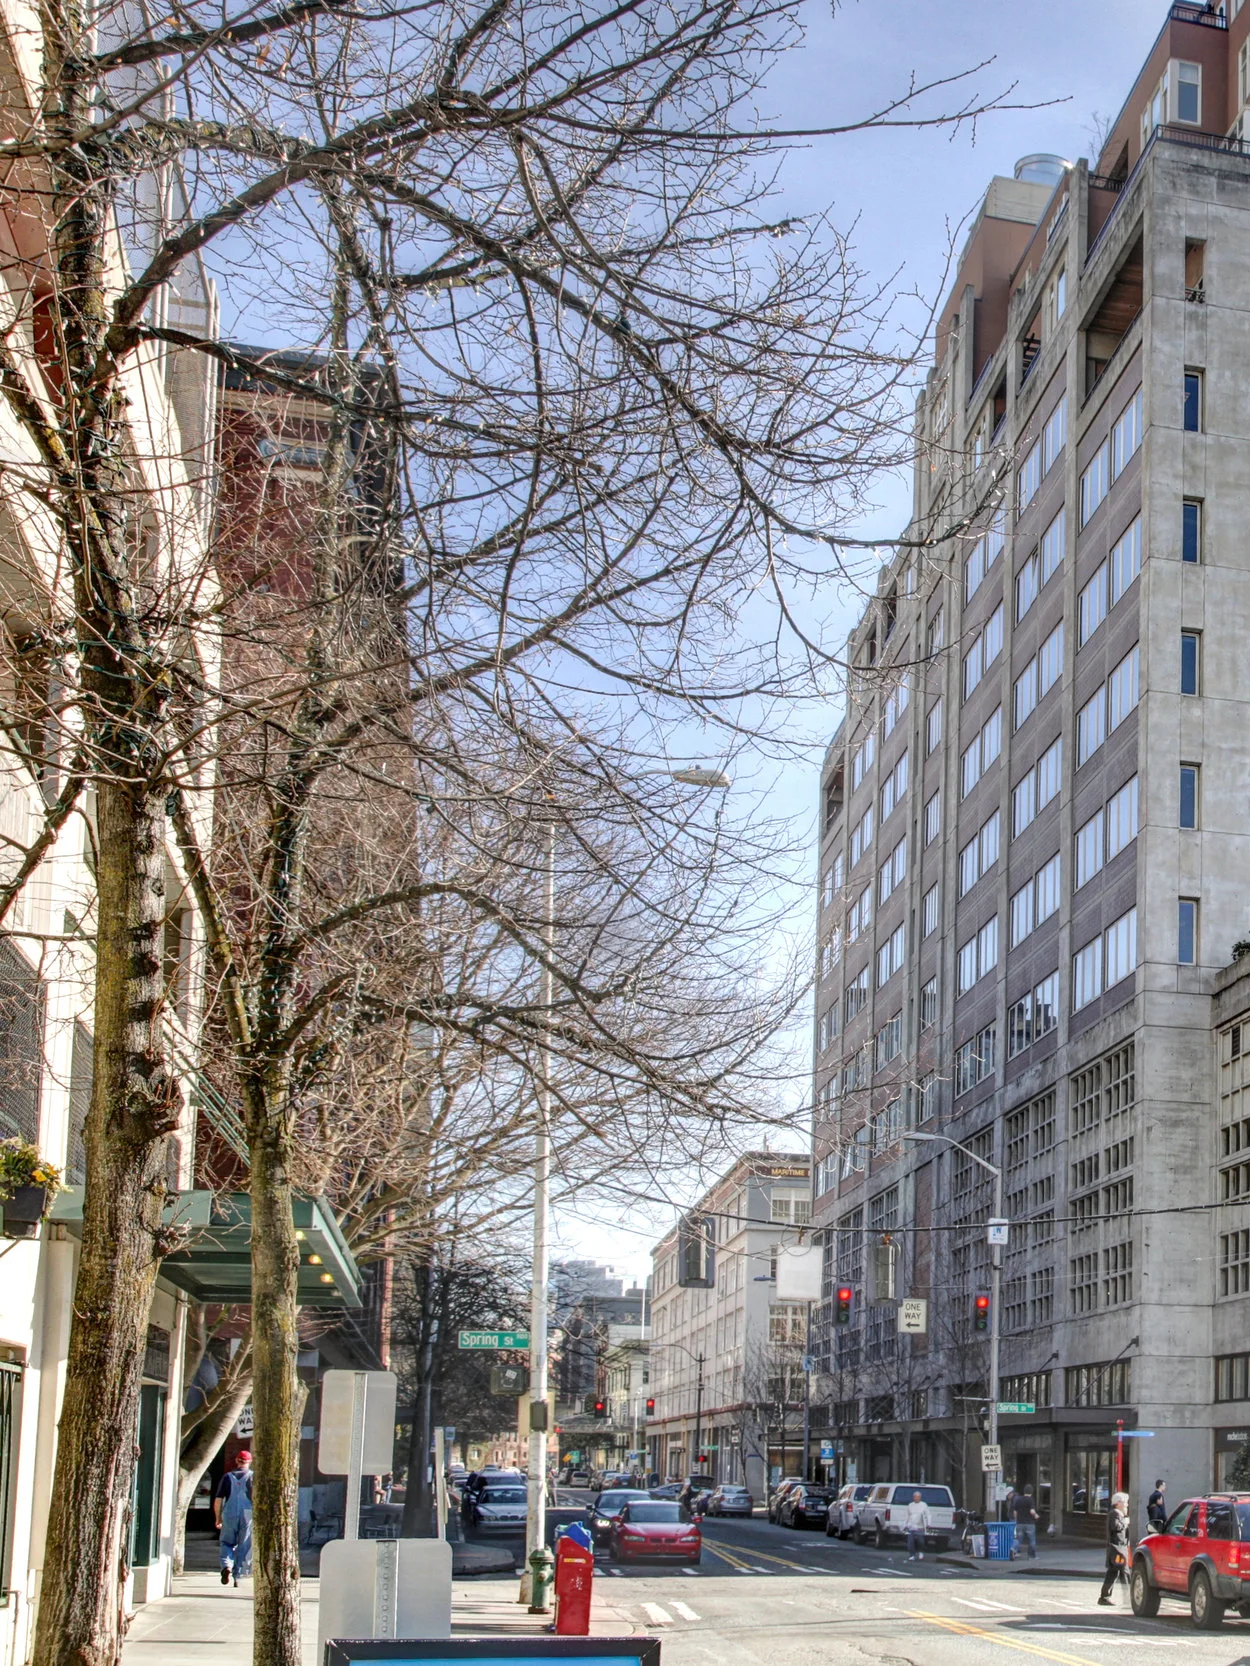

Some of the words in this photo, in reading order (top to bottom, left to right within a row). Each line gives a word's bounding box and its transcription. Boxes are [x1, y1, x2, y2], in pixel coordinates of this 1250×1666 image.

[771, 1168, 805, 1176] MARITIME
[905, 1303, 921, 1311] ONE
[905, 1312, 921, 1320] WAY
[462, 1333, 499, 1348] Spring
[504, 1336, 514, 1346] St
[999, 1403, 1019, 1412] Spring
